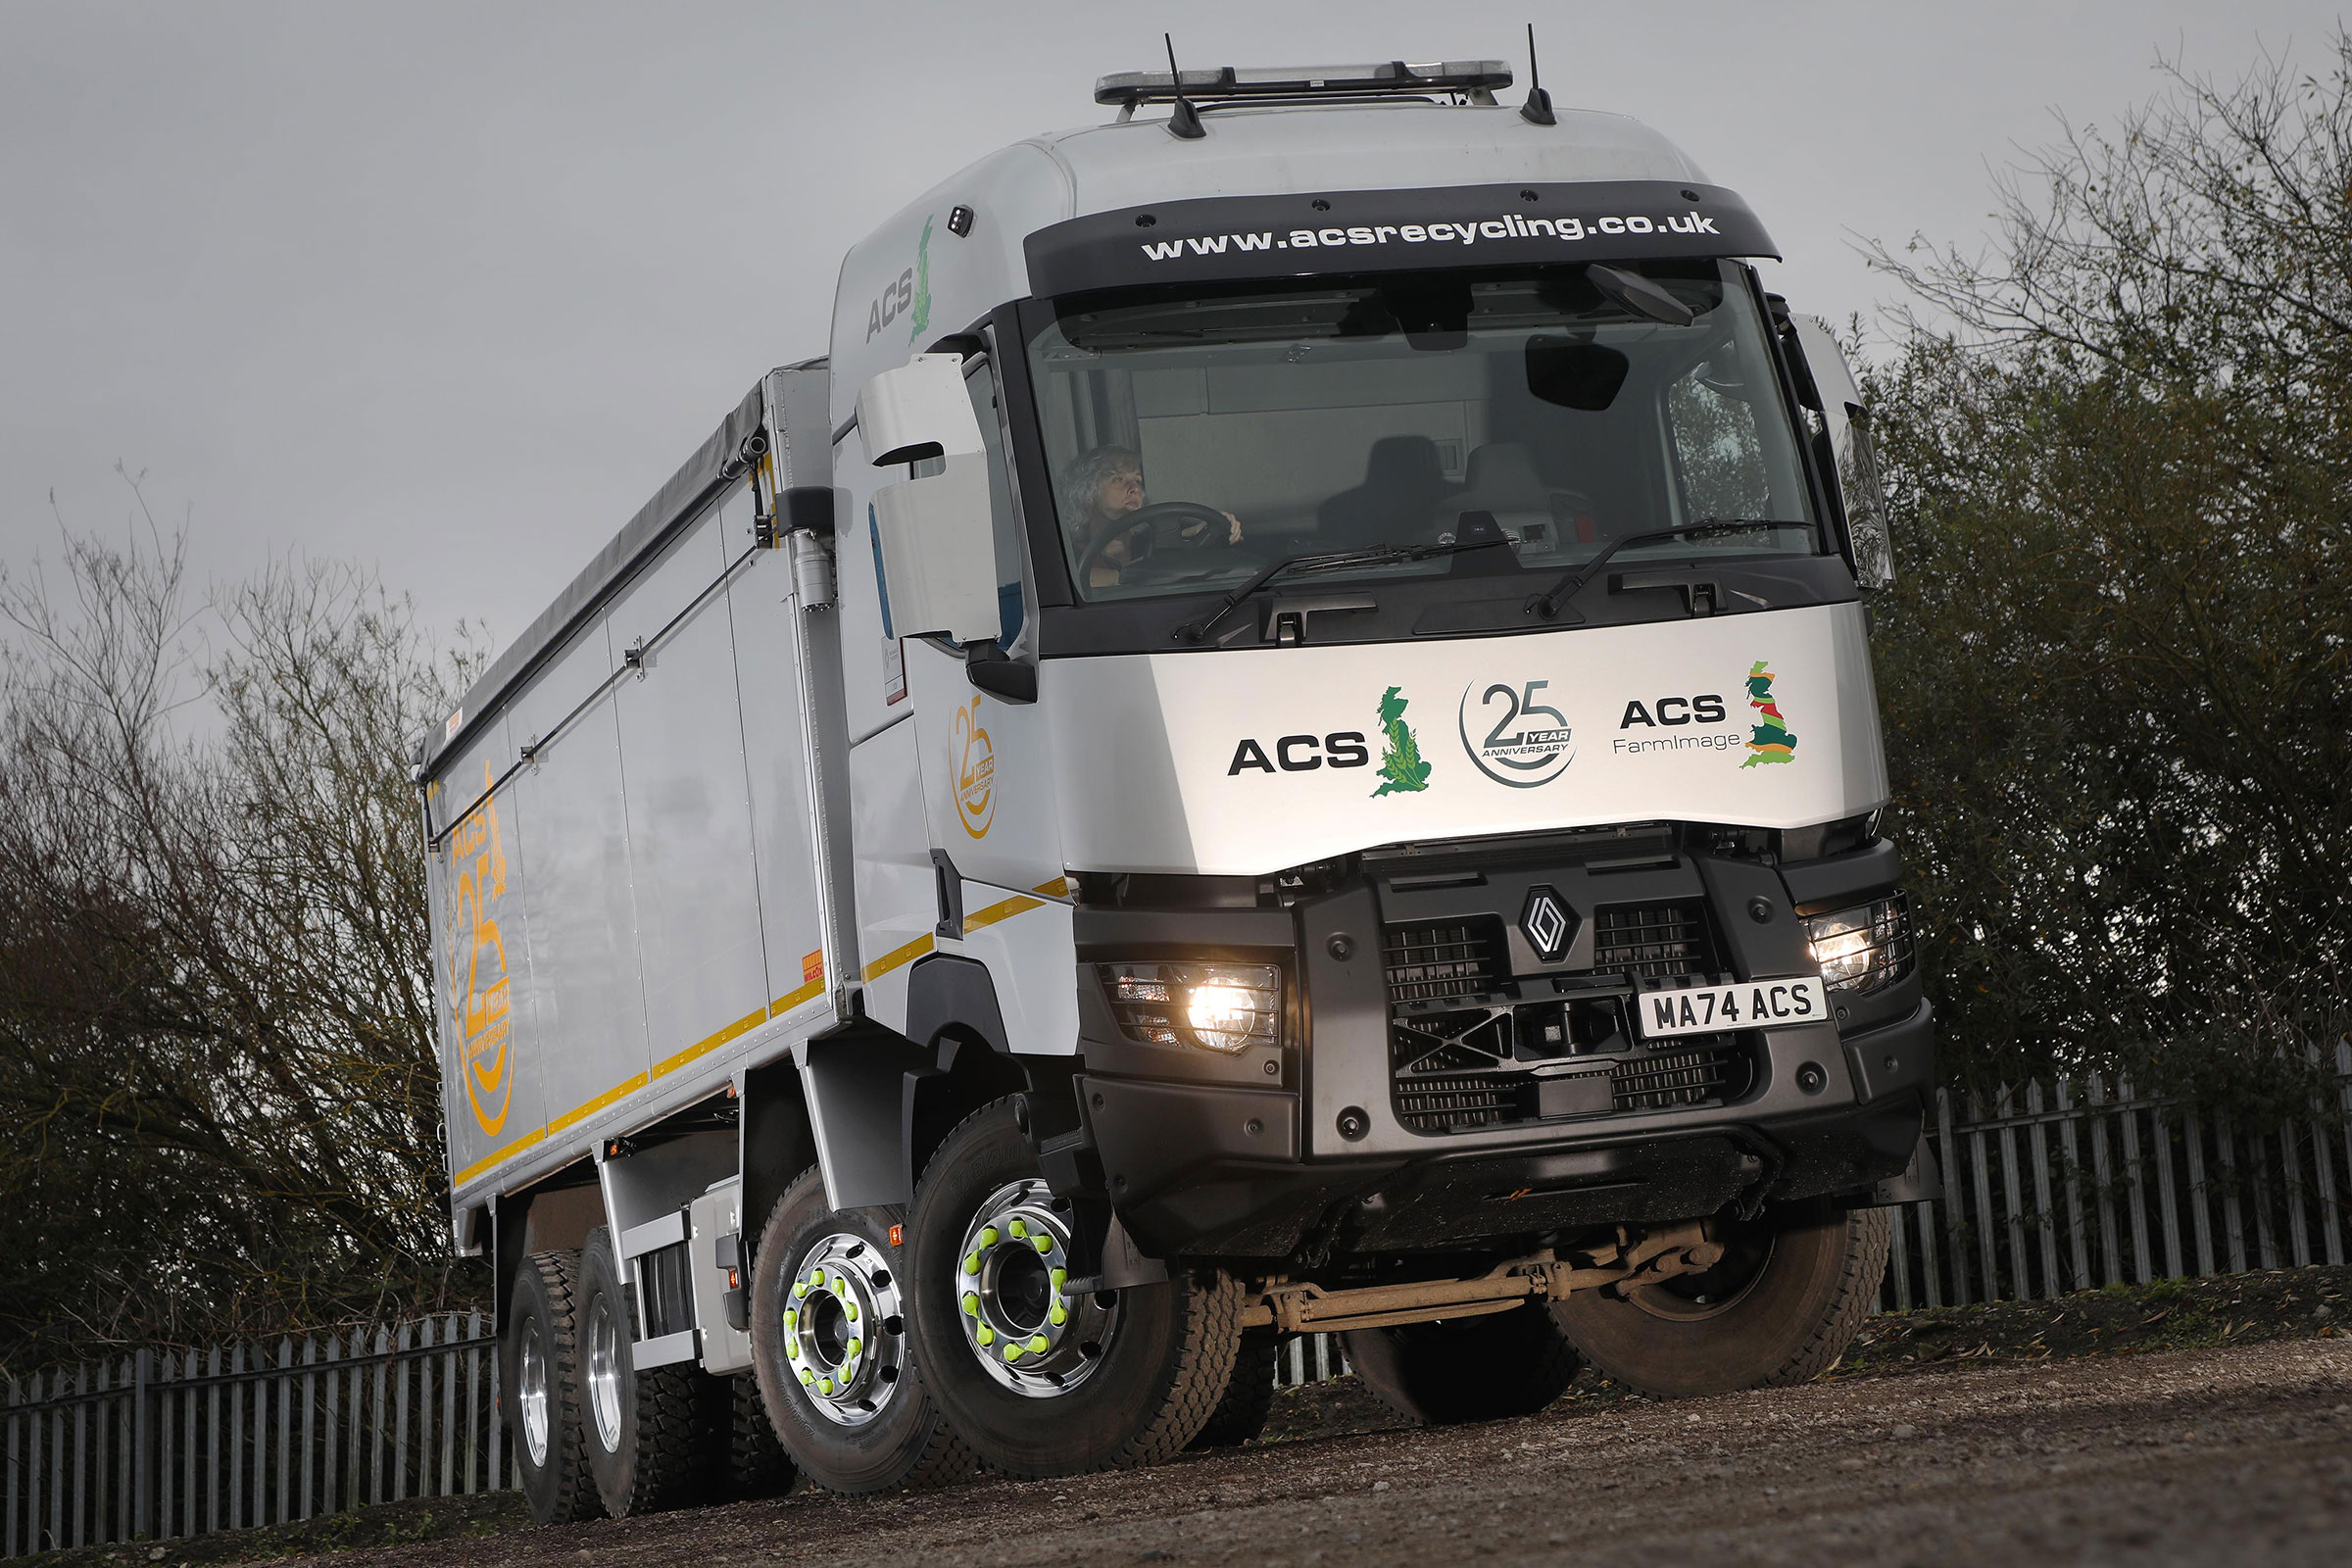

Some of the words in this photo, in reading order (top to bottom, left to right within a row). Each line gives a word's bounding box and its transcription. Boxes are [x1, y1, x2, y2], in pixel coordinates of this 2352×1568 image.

[1142, 210, 1720, 262] www.acsrecycling.co.uk
[866, 268, 912, 344] ACS
[1482, 679, 1569, 749] 25
[1620, 694, 1727, 729] ACS
[956, 694, 993, 792] 25
[1227, 731, 1369, 776] ACS
[1482, 743, 1569, 758] ANNIVERSARY
[1528, 731, 1569, 743] YEAR
[1613, 733, 1741, 755] FarmImage
[960, 776, 995, 802] ANNIVERSARY
[975, 759, 994, 780] YEAR
[457, 850, 508, 1040] 25
[1653, 991, 1740, 1030] MA74
[1752, 984, 1812, 1020] ACS
